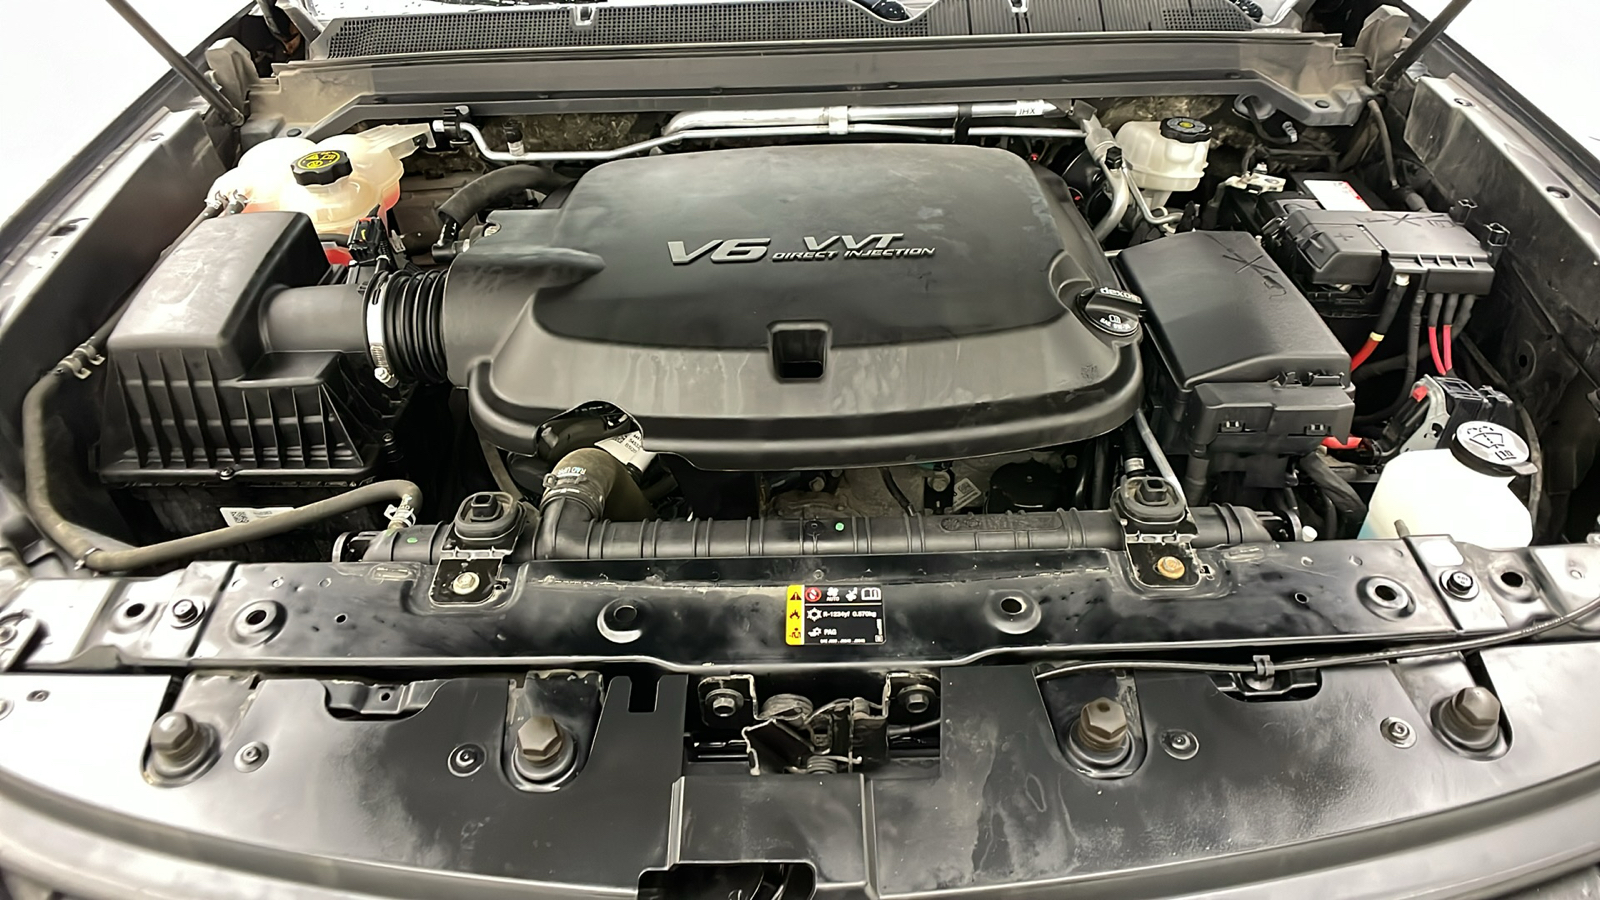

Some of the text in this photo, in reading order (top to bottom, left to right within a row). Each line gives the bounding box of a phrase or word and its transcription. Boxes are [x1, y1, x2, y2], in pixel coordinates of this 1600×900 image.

[803, 232, 904, 250] VVT
[667, 237, 771, 266] V6
[772, 247, 936, 262] DIRECT INJECTION
